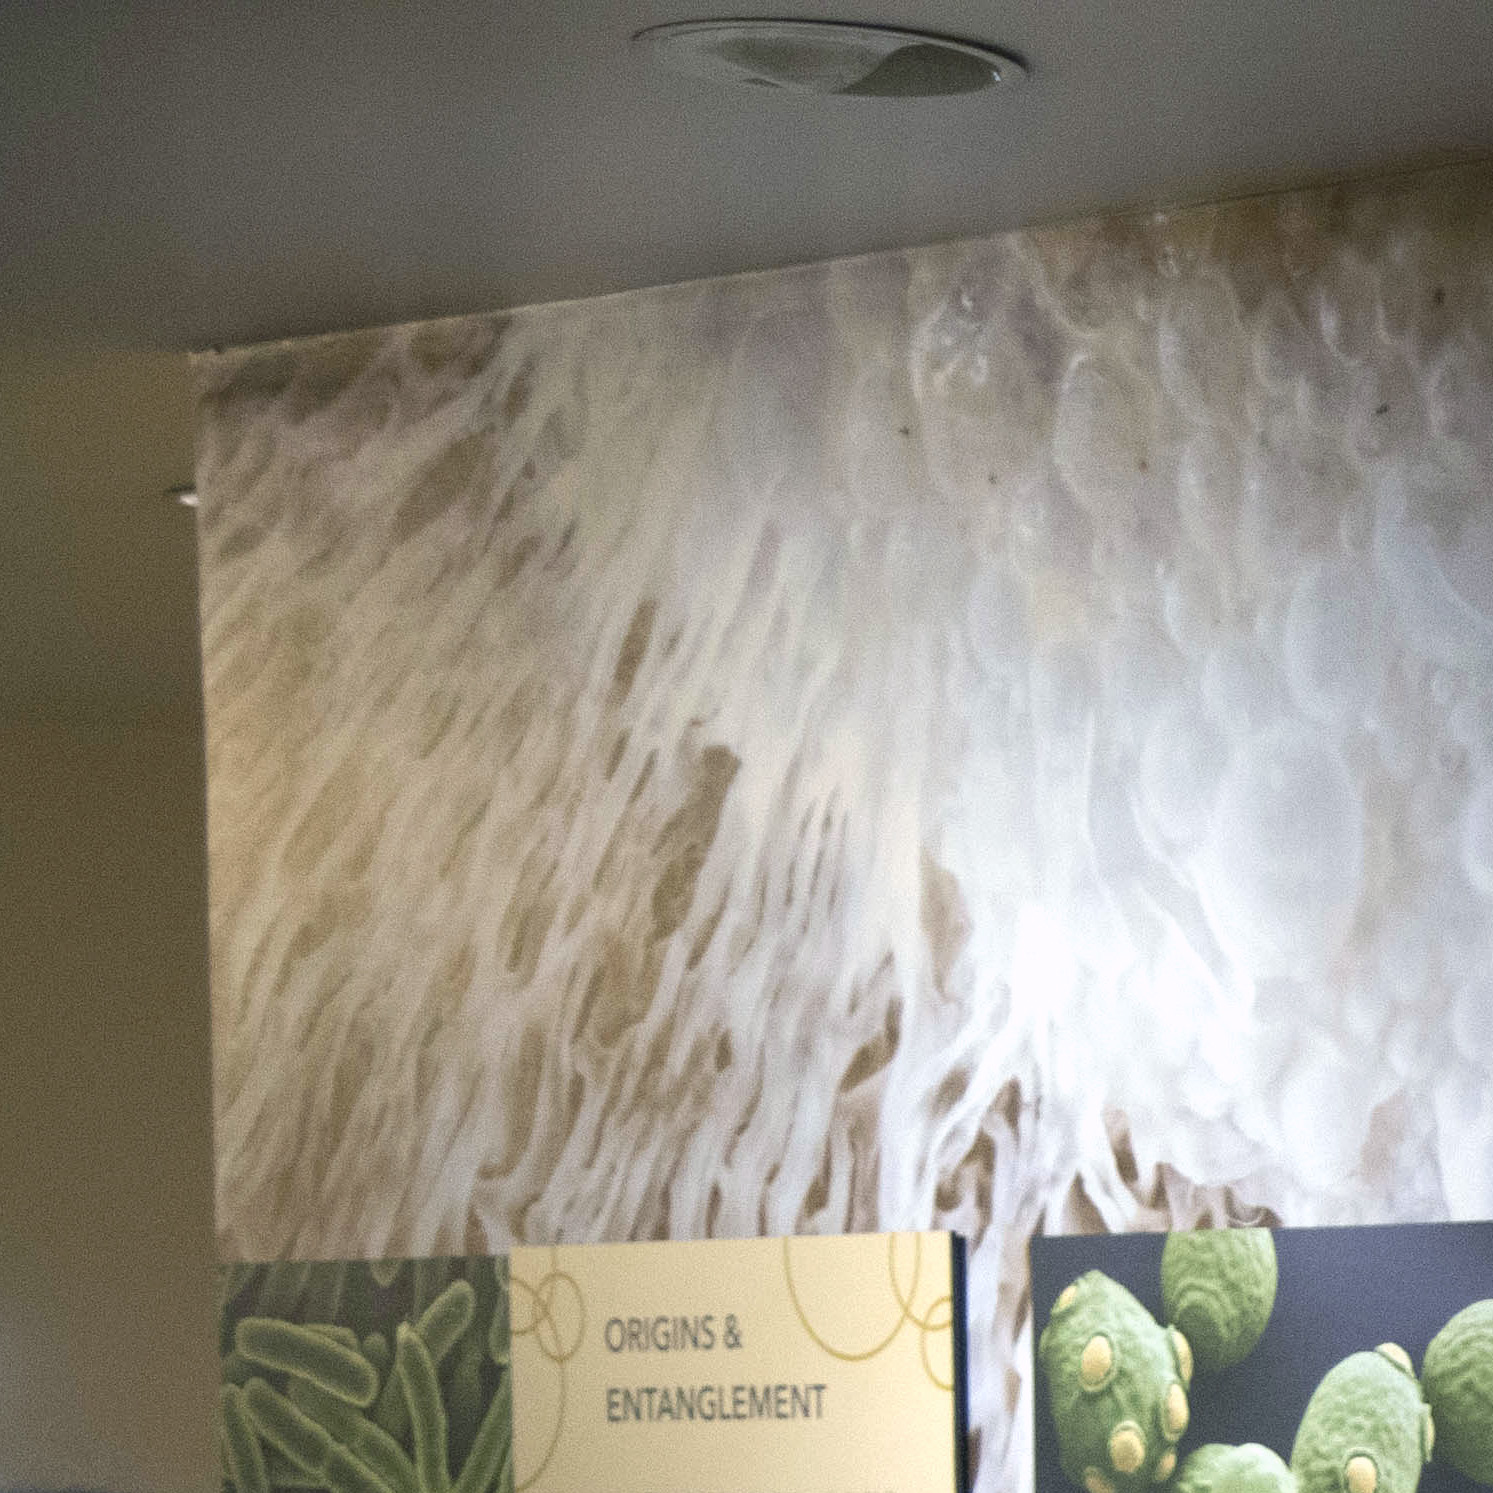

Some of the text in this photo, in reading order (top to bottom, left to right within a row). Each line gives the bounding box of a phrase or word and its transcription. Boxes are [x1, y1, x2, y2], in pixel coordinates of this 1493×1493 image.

[604, 1313, 742, 1352] ORIGINS &
[606, 1382, 827, 1423] ENTANGLEMENT
